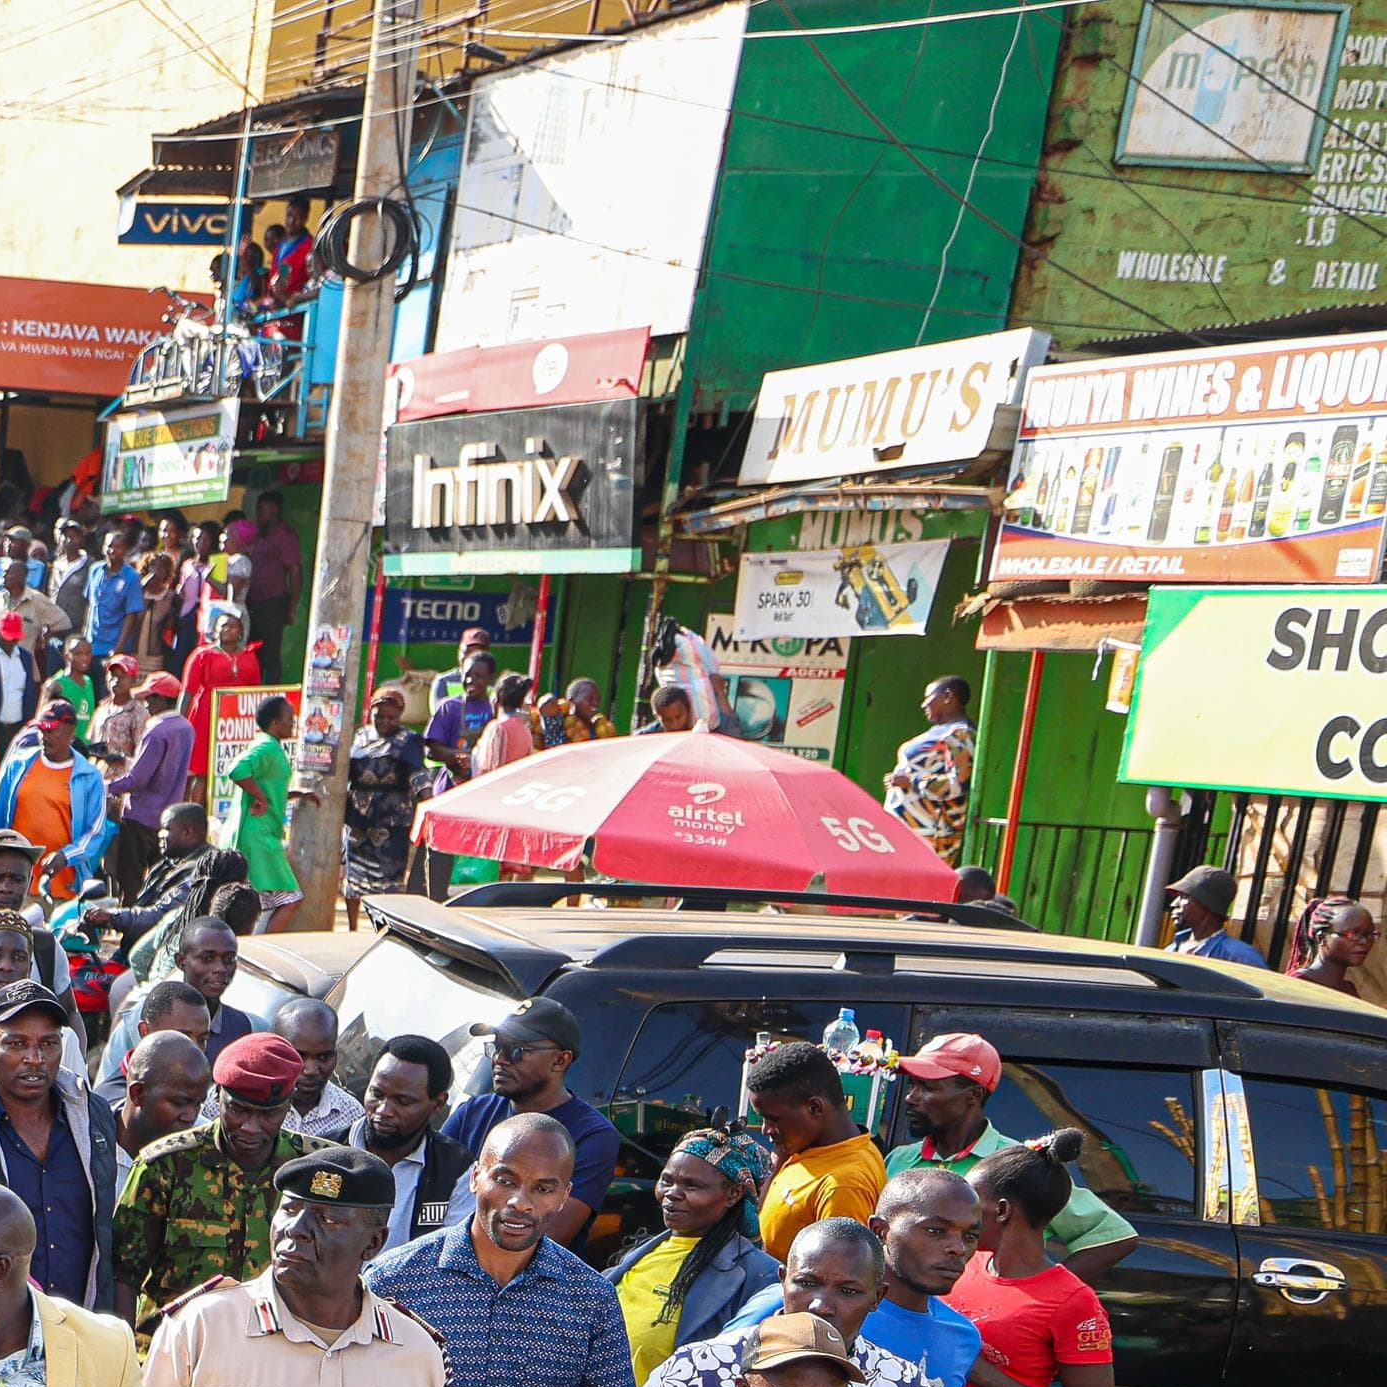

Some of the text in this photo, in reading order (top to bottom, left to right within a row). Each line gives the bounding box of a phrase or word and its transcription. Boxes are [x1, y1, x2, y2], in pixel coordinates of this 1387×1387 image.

[1115, 249, 1379, 291] WHOLESALE & RETAIL
[12, 319, 100, 342] KENJAVA
[20, 343, 69, 357] MWENA
[71, 346, 92, 358] WA
[1129, 359, 1235, 421] WINES
[1237, 363, 1265, 414] &
[767, 360, 993, 461] MUMU'S
[411, 436, 575, 529] Infinix
[797, 508, 925, 550] MUMUS
[999, 555, 1109, 577] WHOLESALE
[1116, 555, 1186, 576] RETAIL
[401, 599, 480, 621] TECNO
[757, 591, 794, 609] SPARK
[786, 668, 838, 679] AGENT
[502, 782, 586, 813] 5G
[667, 804, 747, 828] airtel
[673, 817, 739, 835] money
[821, 815, 897, 854] 5G
